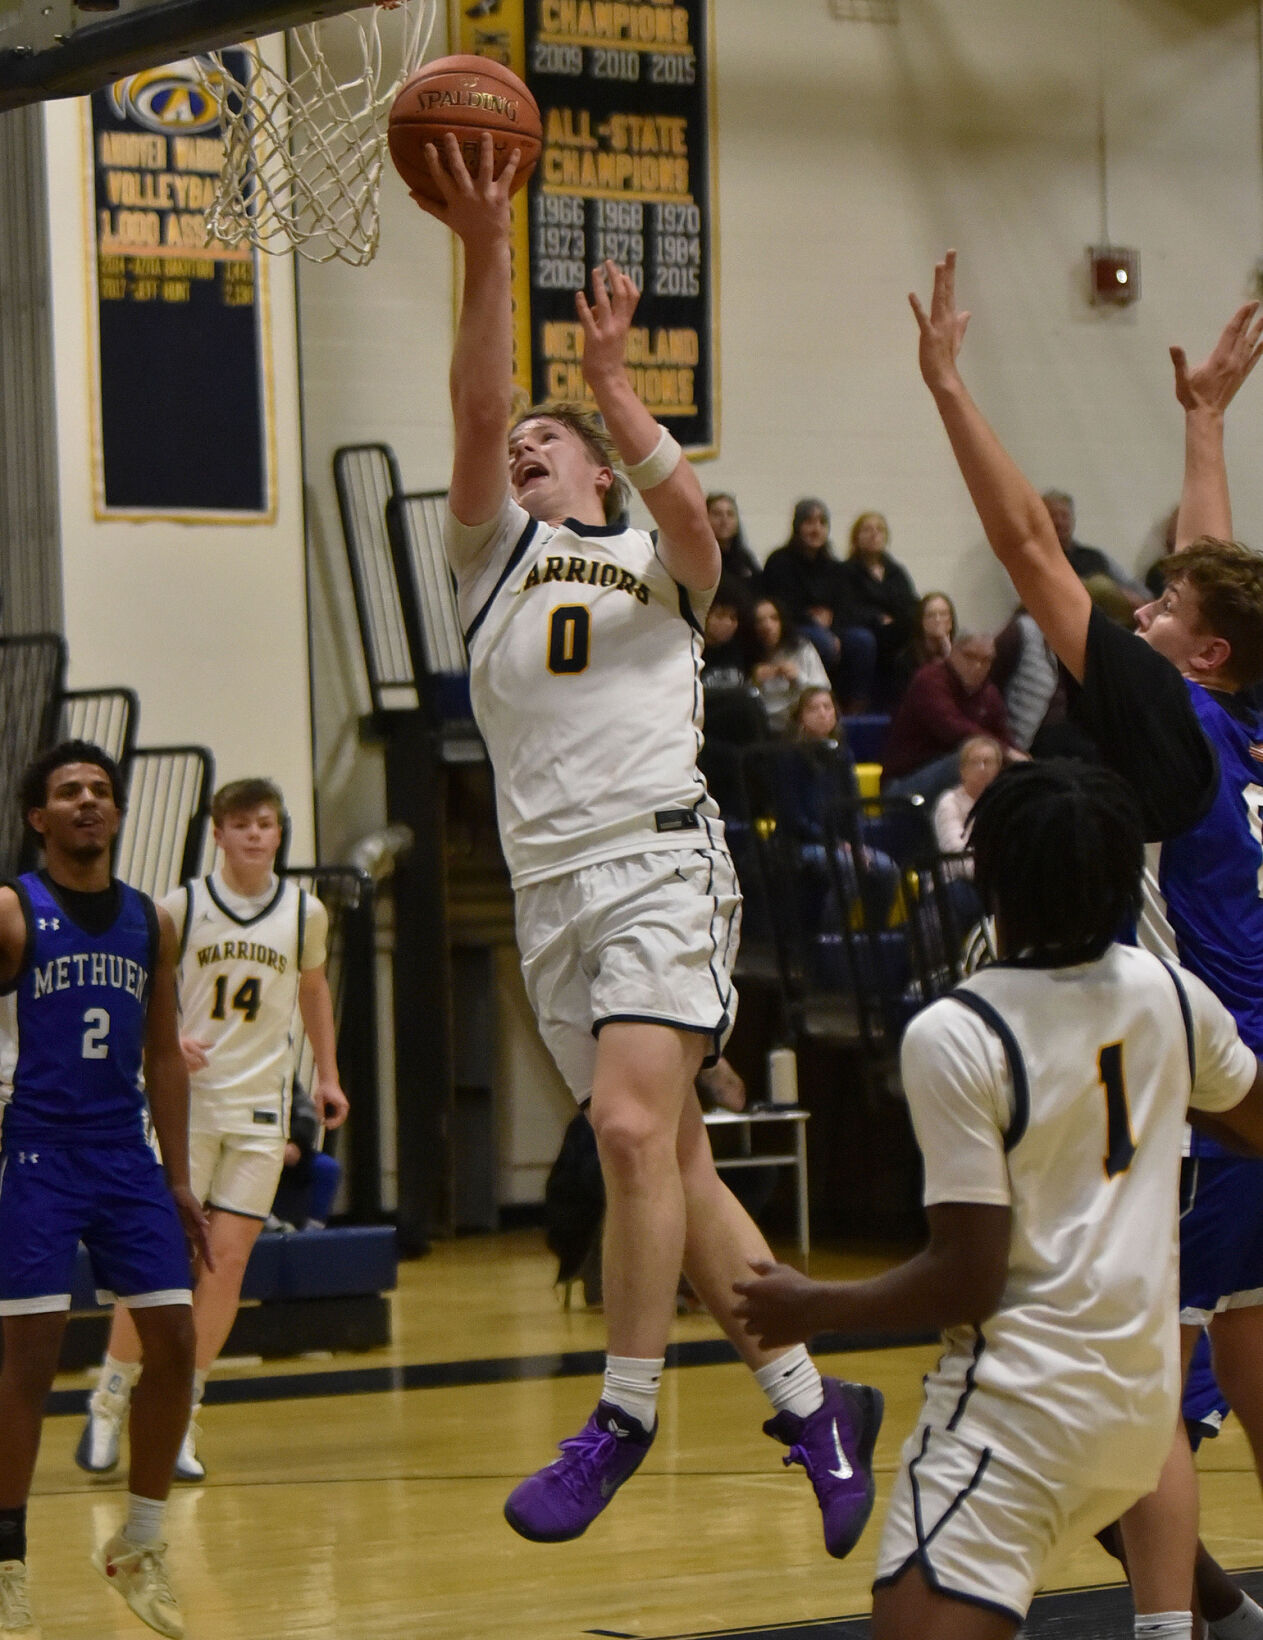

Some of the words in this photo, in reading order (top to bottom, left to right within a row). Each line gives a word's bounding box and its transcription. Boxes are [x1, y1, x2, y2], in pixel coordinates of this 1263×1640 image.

[543, 0, 690, 44] CHAMPIONS
[534, 44, 584, 75] 2009
[594, 50, 640, 81] 2010
[652, 54, 696, 85] 2015
[416, 91, 518, 122] SPALDING
[545, 149, 690, 193] CHAMPIONS
[537, 195, 585, 225] 1966
[598, 199, 643, 230] 1968
[656, 204, 700, 234] 1970
[538, 226, 585, 258] 1973
[598, 231, 644, 263] 1979
[656, 235, 701, 266] 1984
[539, 258, 586, 289] 2009
[656, 266, 700, 297] 2015
[546, 602, 592, 677] 0
[33, 952, 149, 1001] METHUEN
[197, 941, 288, 975] WARRIORS
[210, 974, 262, 1023] 14
[81, 1007, 111, 1060] 2
[1097, 1041, 1137, 1184] 1
